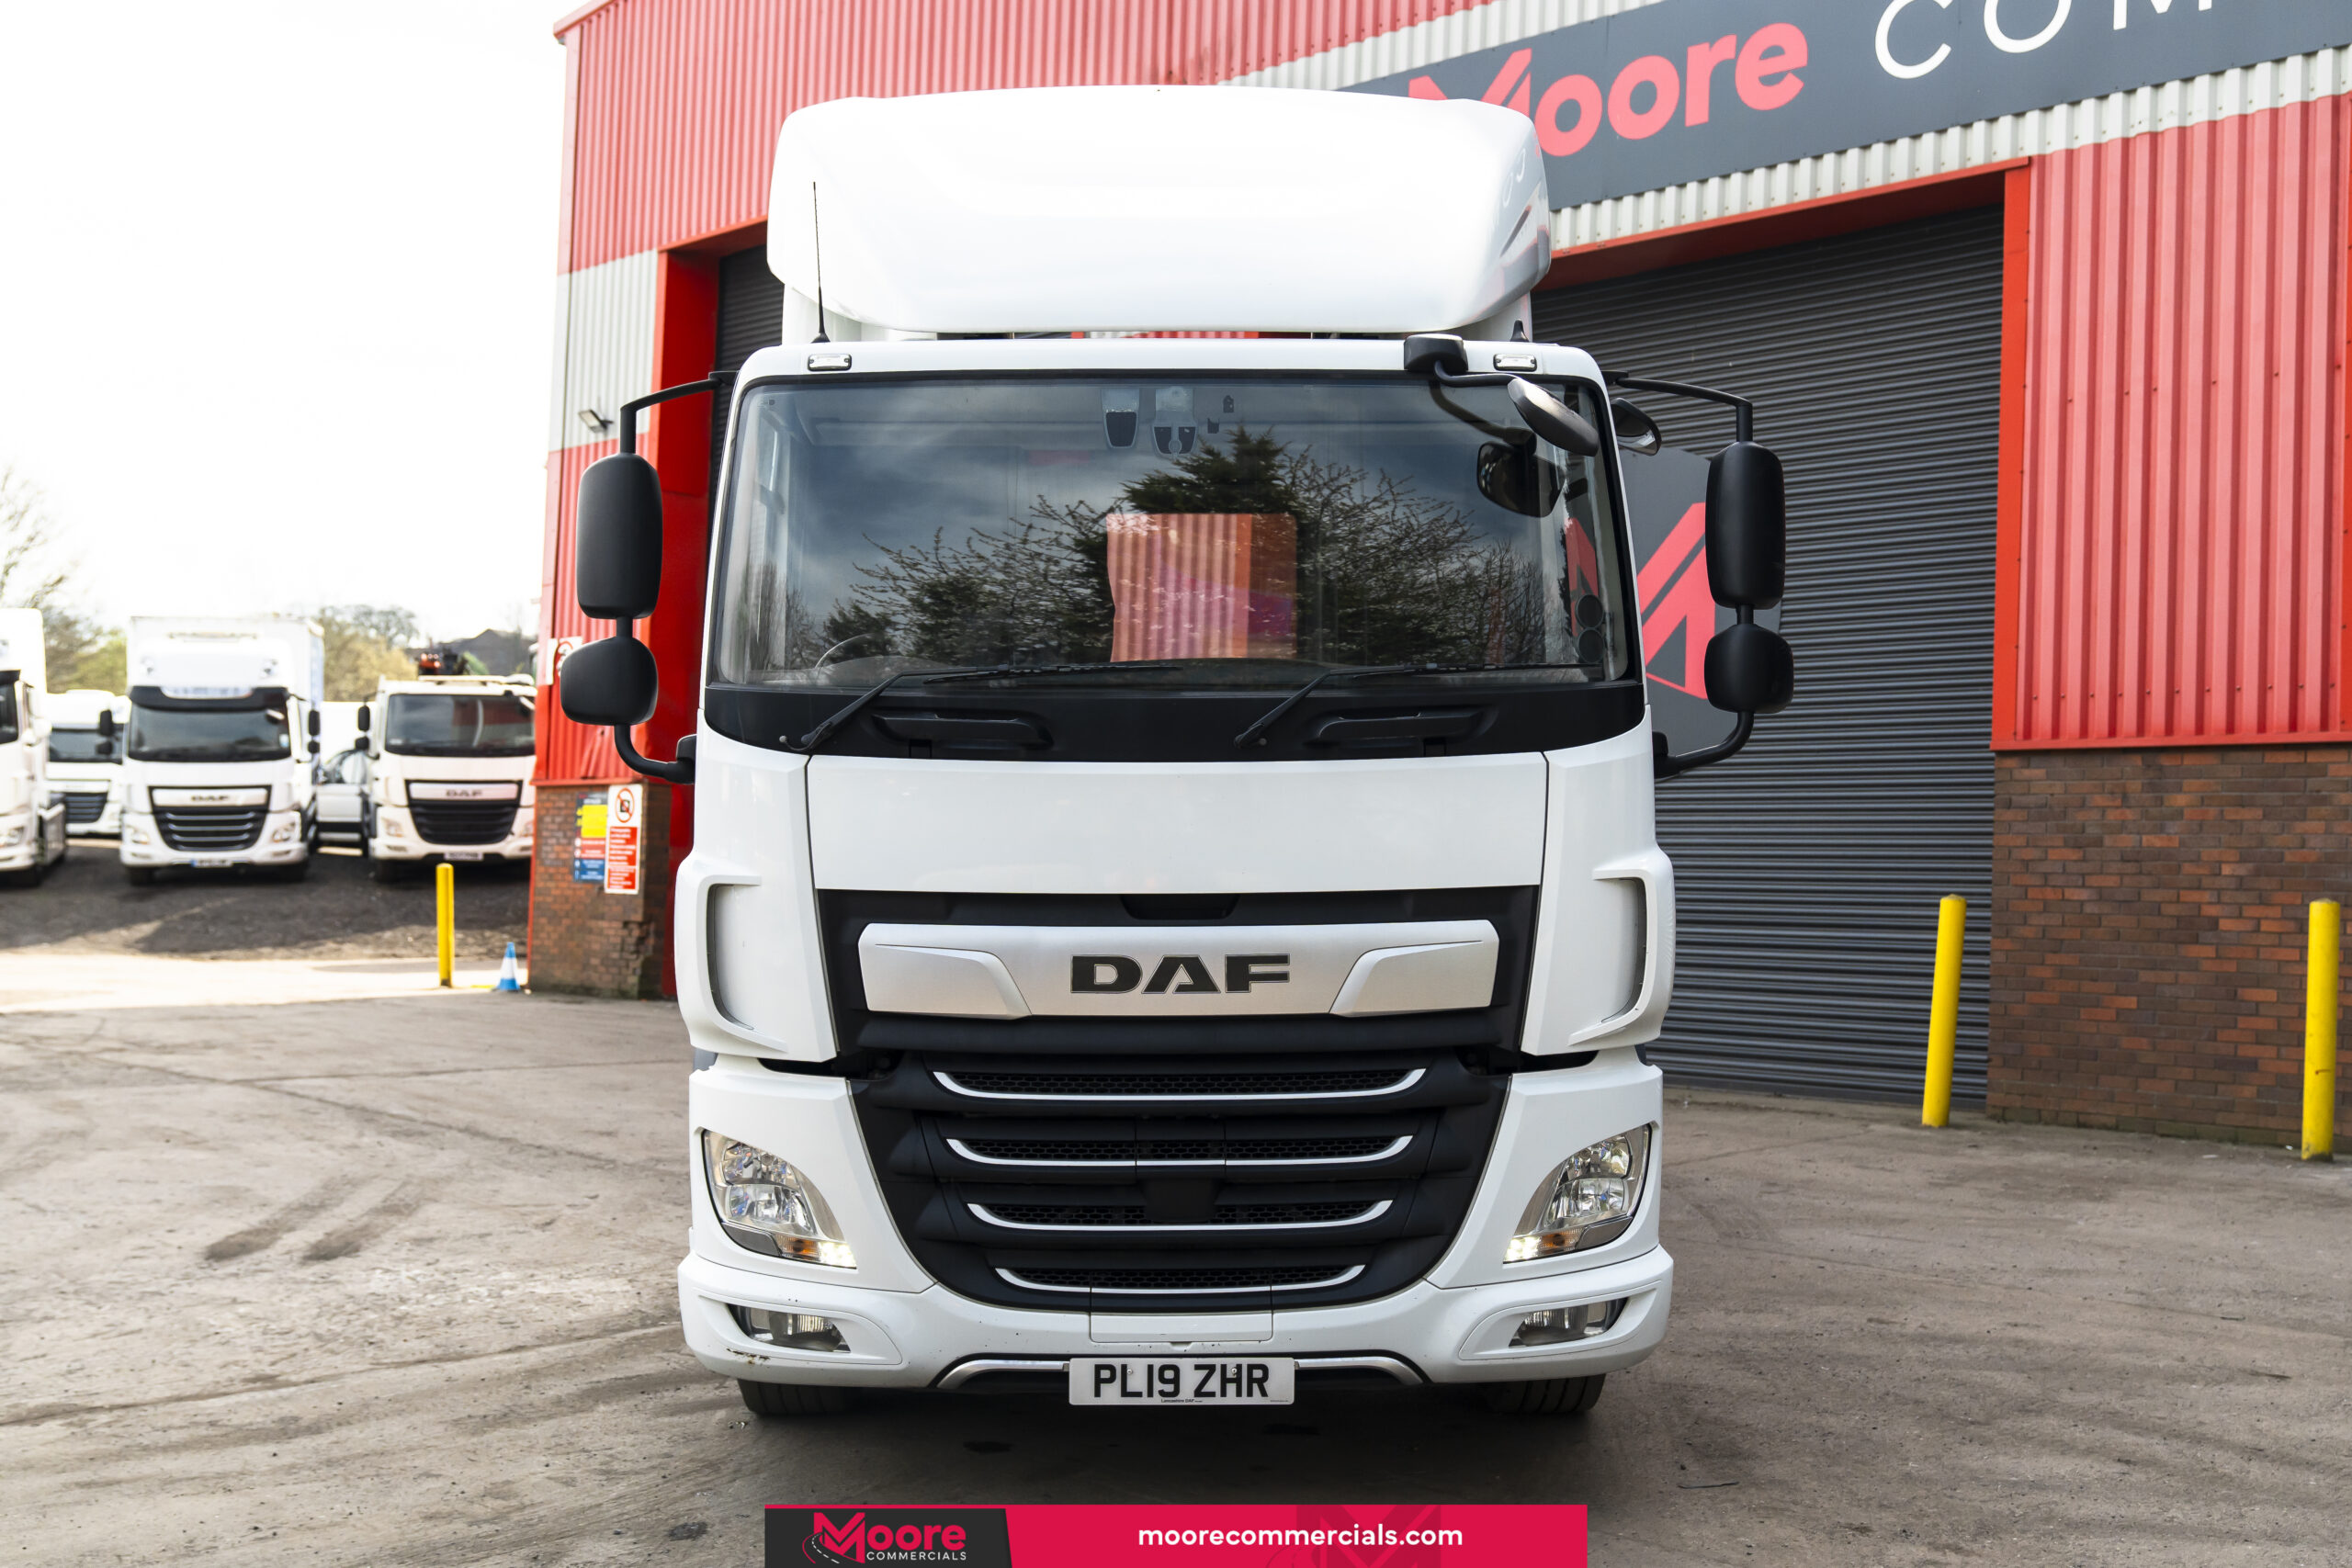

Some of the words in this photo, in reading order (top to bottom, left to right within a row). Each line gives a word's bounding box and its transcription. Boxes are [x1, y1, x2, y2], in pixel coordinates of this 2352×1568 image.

[446, 789, 482, 797] DAF
[1070, 953, 1290, 994] DAF
[1093, 1364, 1181, 1398] PL19
[1193, 1364, 1270, 1398] ZHR
